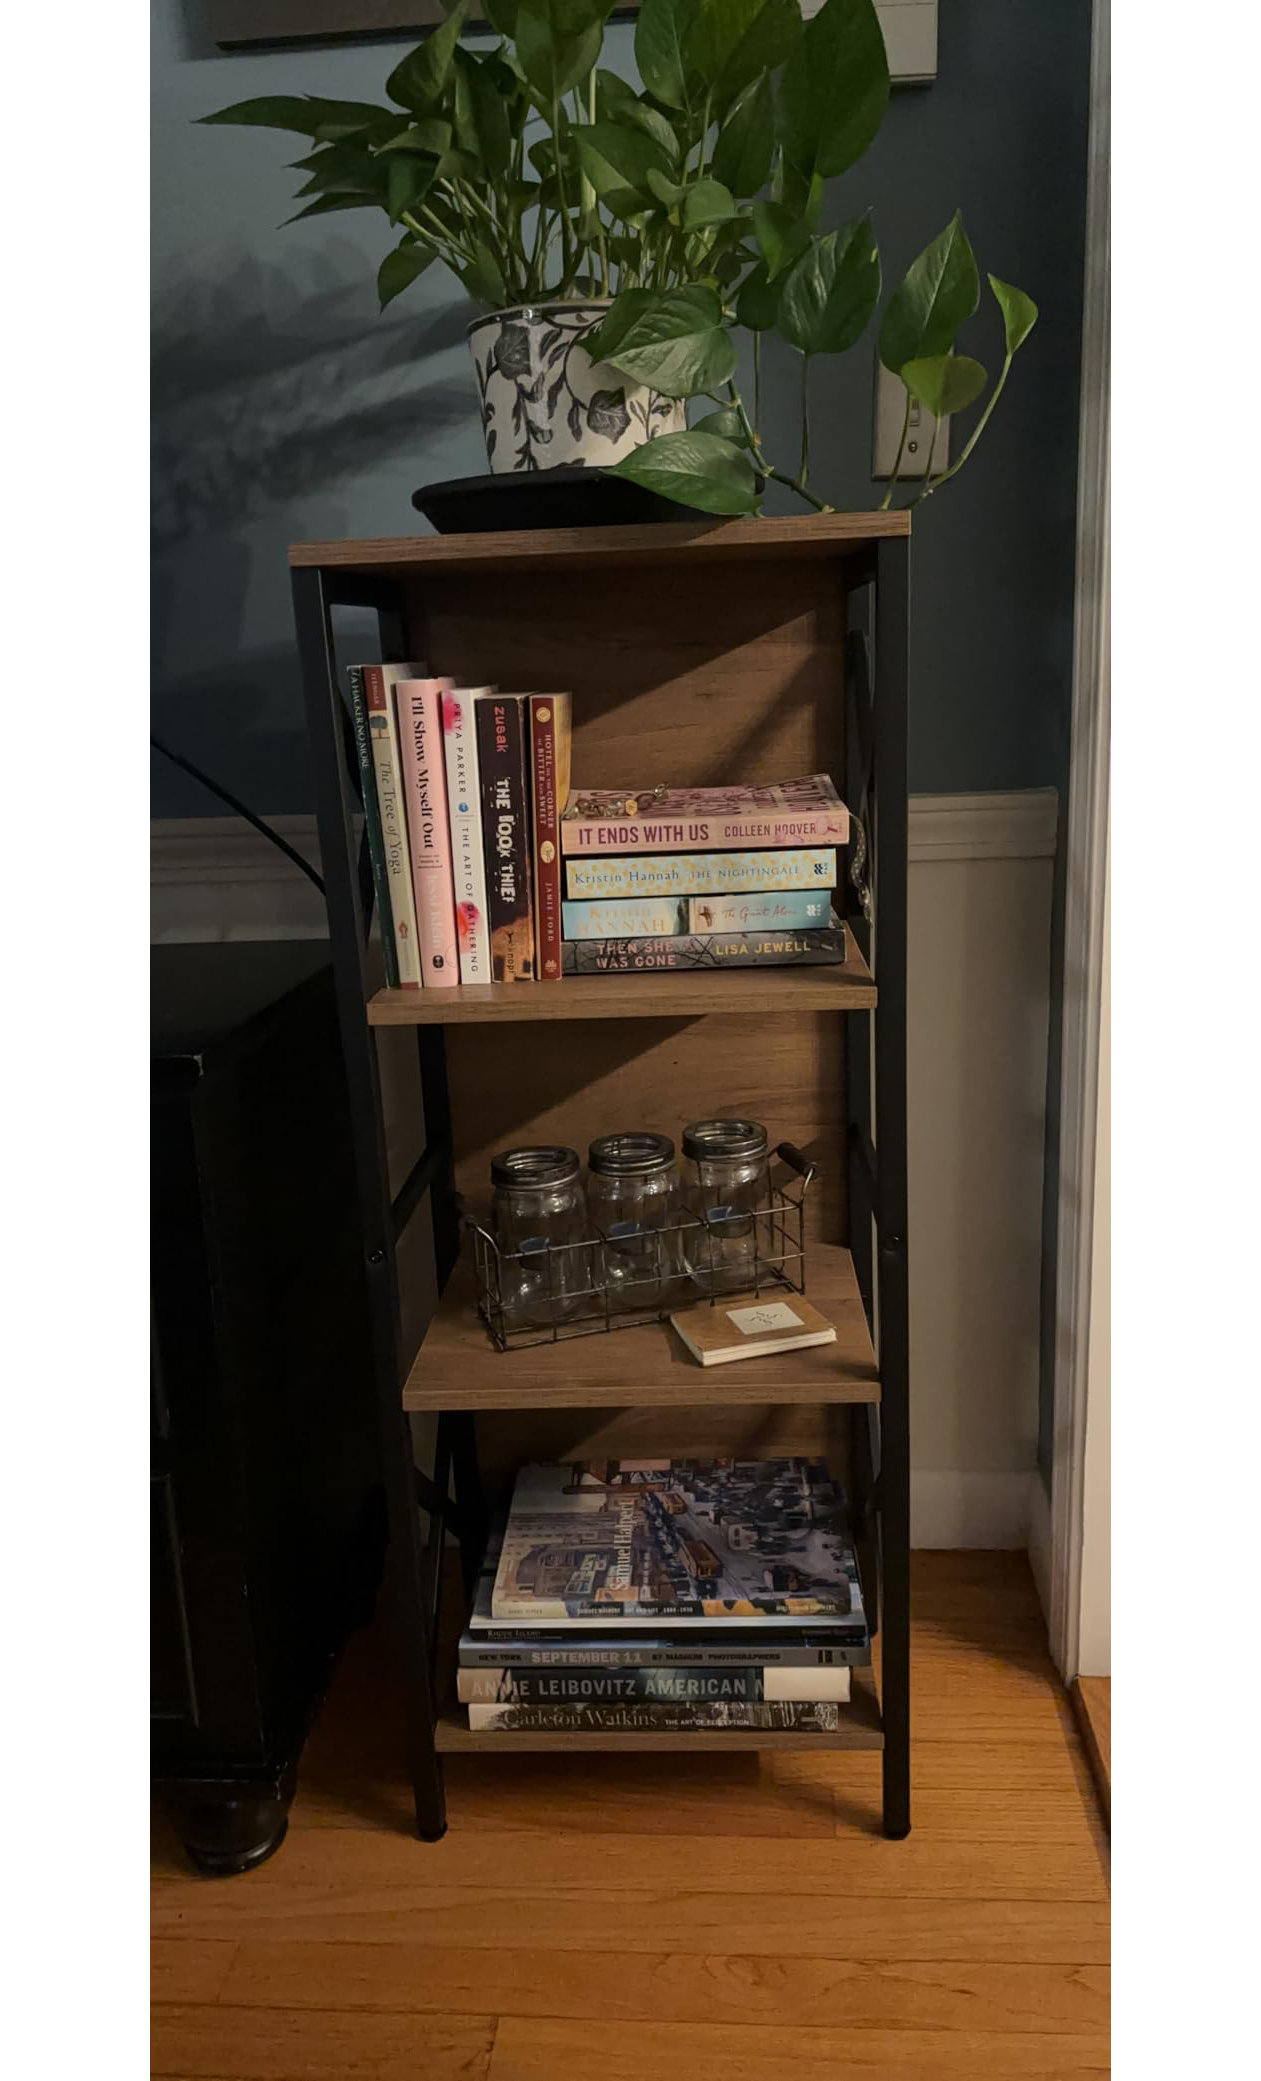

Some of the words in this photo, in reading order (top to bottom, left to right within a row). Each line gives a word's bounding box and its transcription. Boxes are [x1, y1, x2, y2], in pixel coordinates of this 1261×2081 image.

[411, 696, 424, 715] I'll
[454, 703, 463, 739] PRIYA
[413, 721, 427, 762] Show
[544, 734, 552, 765] HOTEL
[380, 761, 391, 784] The
[456, 747, 466, 792] PARKER
[383, 788, 396, 819] Tree
[416, 768, 433, 818] Myself
[495, 777, 511, 810] THE
[539, 796, 547, 825] SWEET
[386, 825, 398, 836] of
[422, 822, 434, 849] Out
[461, 827, 470, 848] THE
[579, 828, 593, 845] IT
[597, 826, 639, 844] ENDS
[643, 824, 684, 842] WITH
[689, 823, 709, 841] US
[724, 824, 771, 837] COLLEEN
[774, 822, 817, 836] HOOVER
[388, 841, 402, 875] Yoga
[463, 855, 472, 877] ART
[500, 862, 515, 903] THIEF
[575, 871, 622, 885] Kristin
[629, 869, 679, 883] Hannah
[690, 870, 711, 880] THE
[717, 866, 800, 878] NIGHTINGALE
[465, 884, 474, 897] OF
[545, 882, 554, 910] JAMIE
[467, 902, 479, 972] GATHERING
[546, 916, 555, 942] FORD
[576, 919, 665, 935] HANNAH
[596, 943, 637, 955] THEN
[644, 941, 675, 953] SHE
[715, 943, 748, 956] LISA
[754, 941, 811, 955] JEWELL
[597, 957, 628, 969] WAS
[635, 955, 677, 967] GONE
[614, 1501, 636, 1544] Halpert
[610, 1546, 631, 1590] Samuel
[531, 1652, 620, 1664] SEPTEMBER
[623, 1652, 643, 1664] 11
[708, 1653, 781, 1661] PHOTOGRAPHERS
[471, 1679, 530, 1696] ANNIE
[538, 1679, 636, 1696] LEIBOVITZ
[644, 1678, 747, 1696] AMERICAN
[503, 1710, 582, 1726] Carleton
[585, 1710, 658, 1726] Watkins
